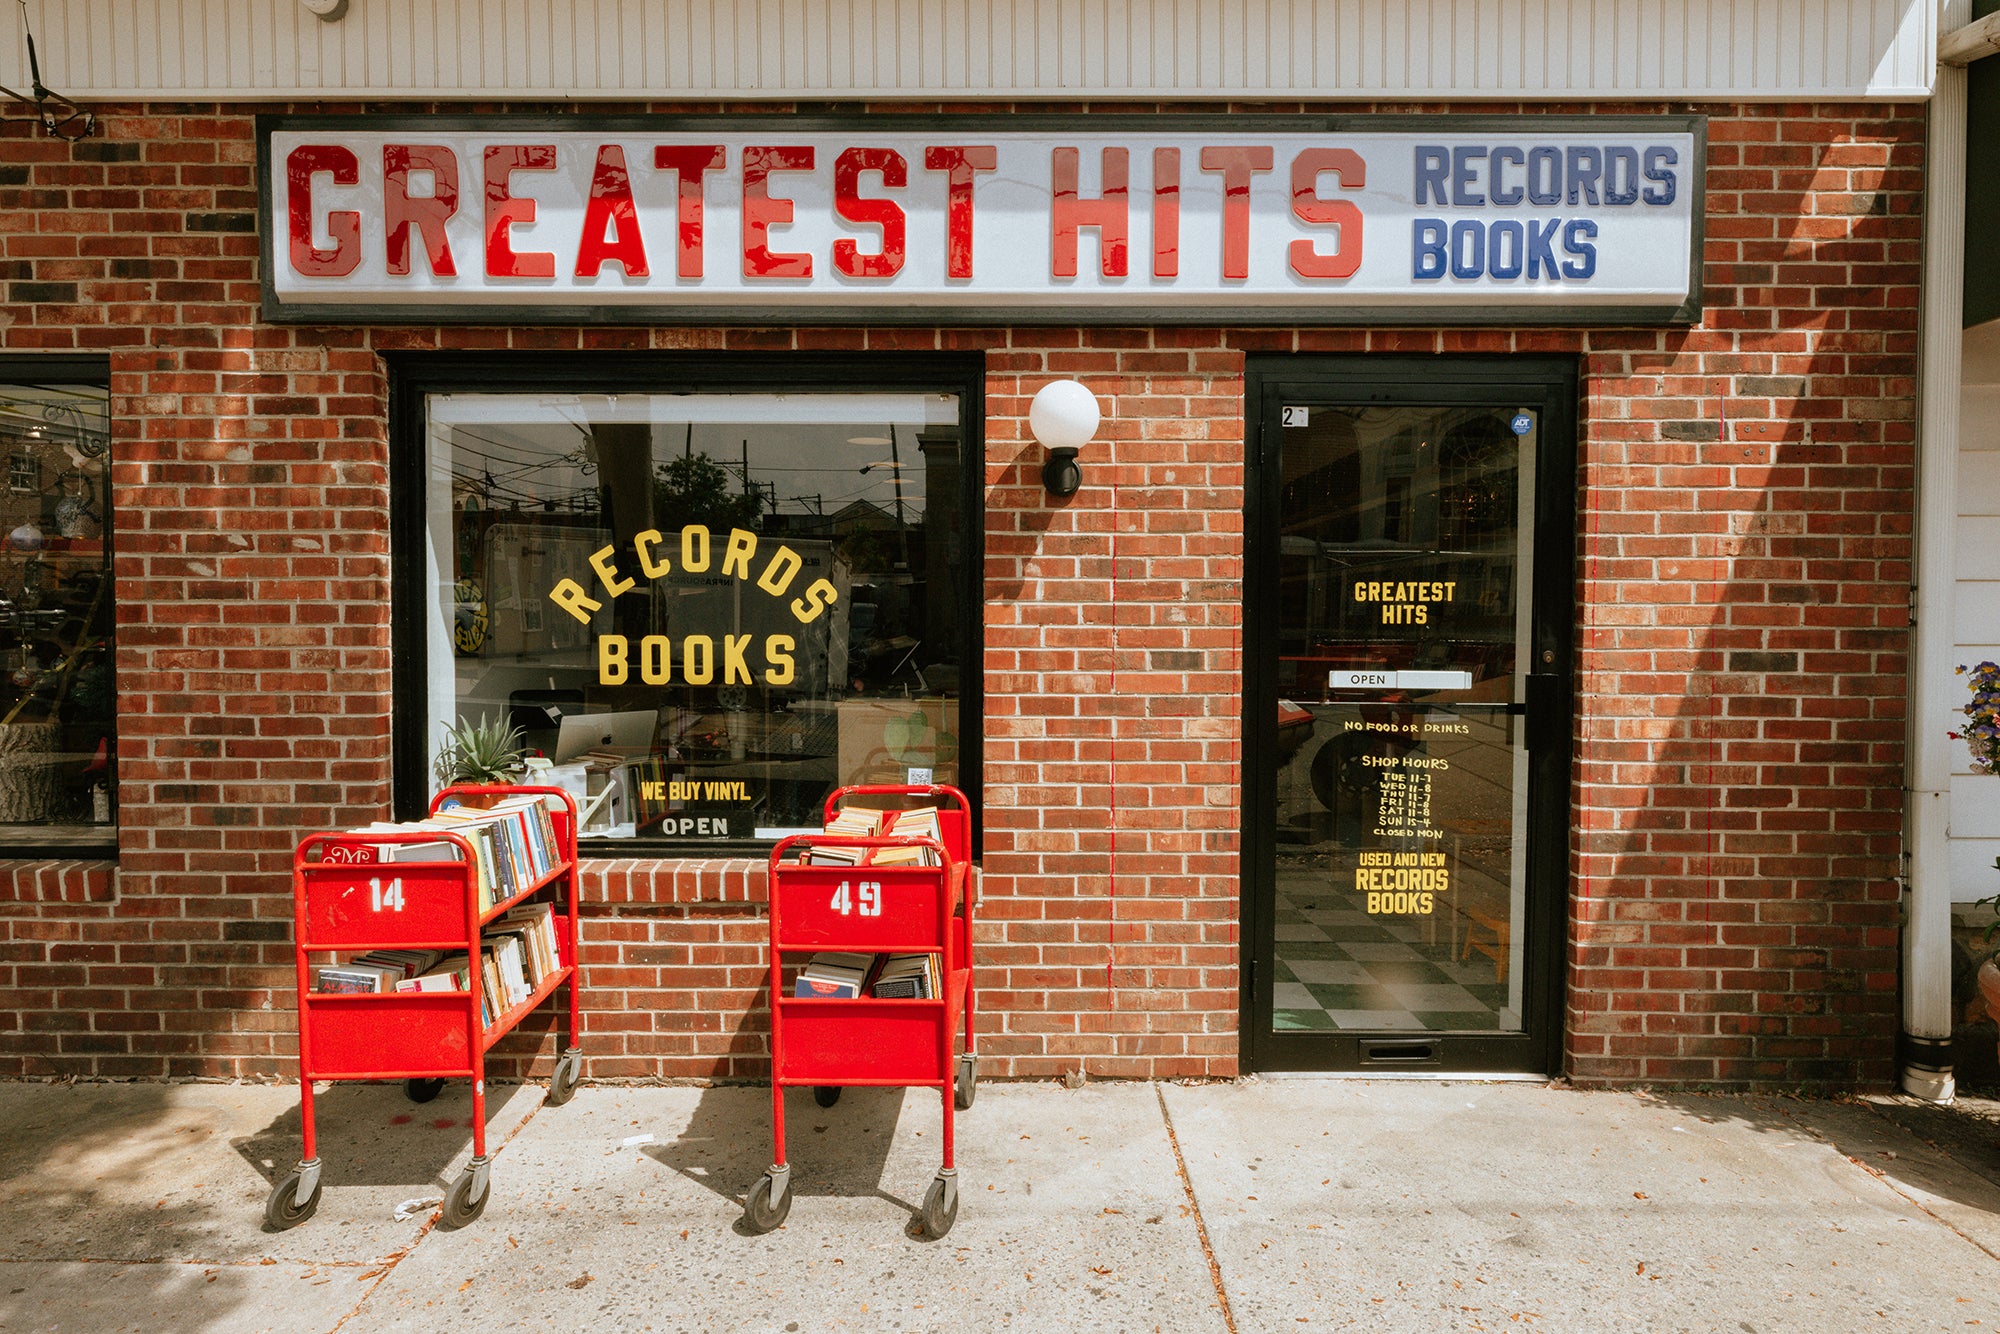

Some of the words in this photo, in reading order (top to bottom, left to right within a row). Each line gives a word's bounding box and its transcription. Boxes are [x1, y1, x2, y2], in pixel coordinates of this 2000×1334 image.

[1414, 145, 1678, 207] RECORDS
[286, 144, 997, 279] GREATEST
[1052, 146, 1366, 279] HITS
[1412, 218, 1598, 281] BOOKS
[549, 525, 838, 625] RECORDS
[1354, 582, 1456, 602] GREATEST
[1382, 604, 1428, 625] HITS
[599, 634, 796, 686] BOOKS
[1350, 674, 1386, 685] OPEN
[1344, 721, 1363, 731] NO
[1366, 722, 1399, 732] FOOD
[1402, 724, 1419, 733] OR
[1424, 723, 1470, 734] DRINKS
[1362, 755, 1399, 768] SHOP
[1402, 757, 1449, 770] HOURS
[1382, 772, 1406, 782] TUE
[1410, 774, 1431, 783] 11-7
[640, 781, 666, 801] WE
[669, 781, 702, 801] BUY
[704, 781, 752, 801] VINYL
[1380, 782, 1406, 790] WED
[1409, 784, 1431, 793] 11-8
[1380, 790, 1405, 798] THU
[1408, 792, 1431, 802] 11-7
[1379, 806, 1404, 815] SAT
[1408, 808, 1430, 817] 11-8
[1381, 798, 1402, 806] FRI
[662, 817, 729, 836] OPEN
[1379, 816, 1402, 826] SUN
[1373, 828, 1414, 837] CLOSED
[1417, 829, 1443, 839] MON
[1359, 852, 1391, 867] USED
[1393, 852, 1419, 867] AND
[1420, 852, 1446, 867] NEW
[1355, 868, 1449, 891] RECORDS
[369, 878, 405, 912] 14
[831, 881, 881, 917] 49
[1367, 891, 1433, 915] BOOKS
